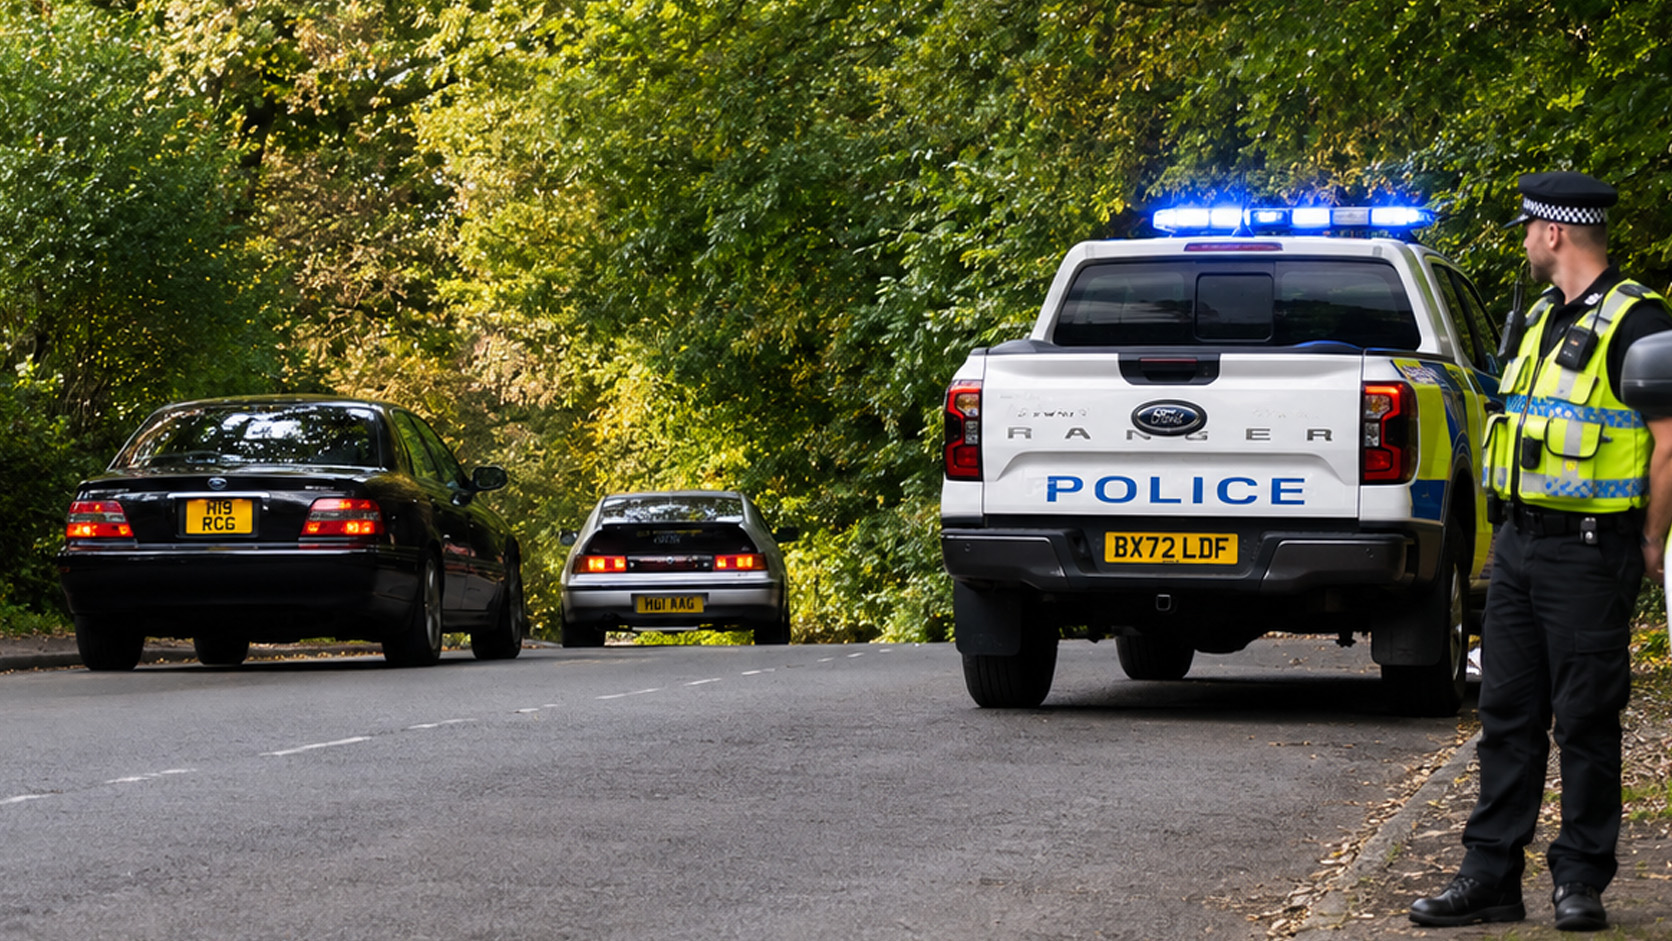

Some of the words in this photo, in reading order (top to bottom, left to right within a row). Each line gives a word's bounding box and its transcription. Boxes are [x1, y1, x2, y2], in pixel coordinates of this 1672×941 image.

[1046, 475, 1306, 505] POLICE
[1113, 535, 1176, 559] BX72
[1182, 536, 1230, 560] LDF
